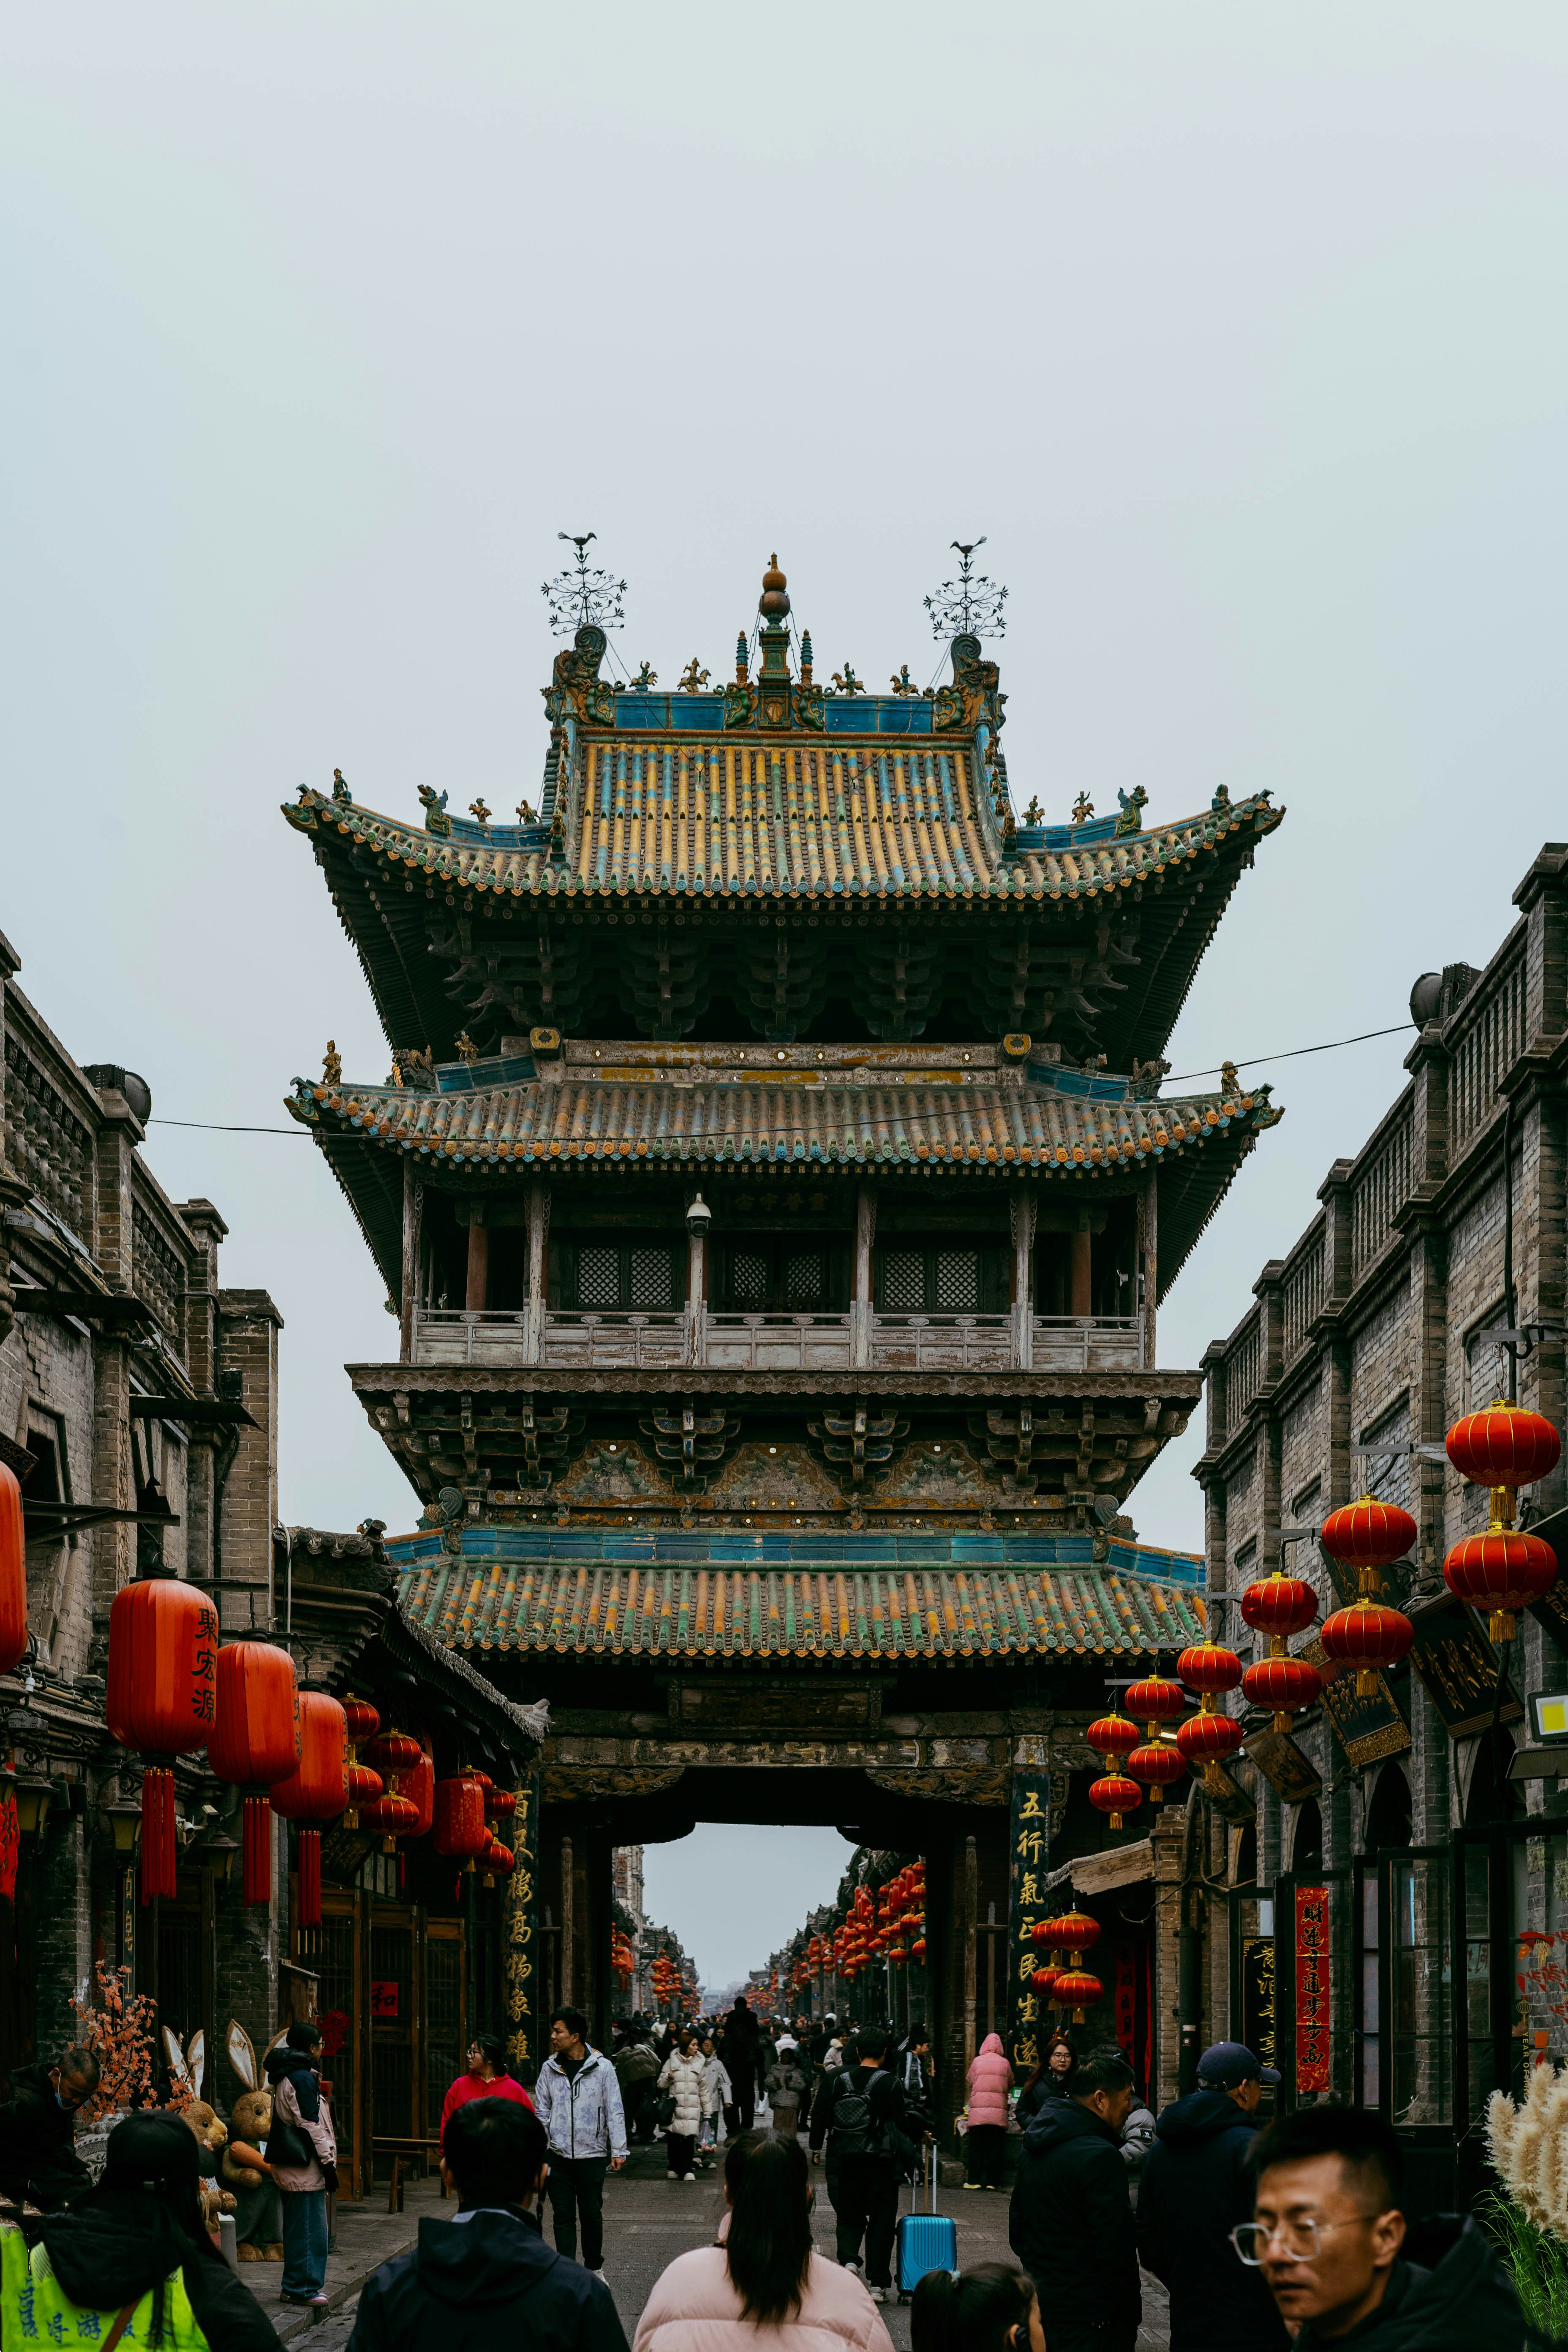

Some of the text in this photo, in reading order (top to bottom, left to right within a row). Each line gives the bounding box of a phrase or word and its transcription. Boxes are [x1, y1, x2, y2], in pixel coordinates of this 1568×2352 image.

[191, 1608, 218, 1723] 聚宏源
[1301, 1901, 1325, 2065] 財運亨通步步高
[1523, 2062, 1529, 2075] OF
